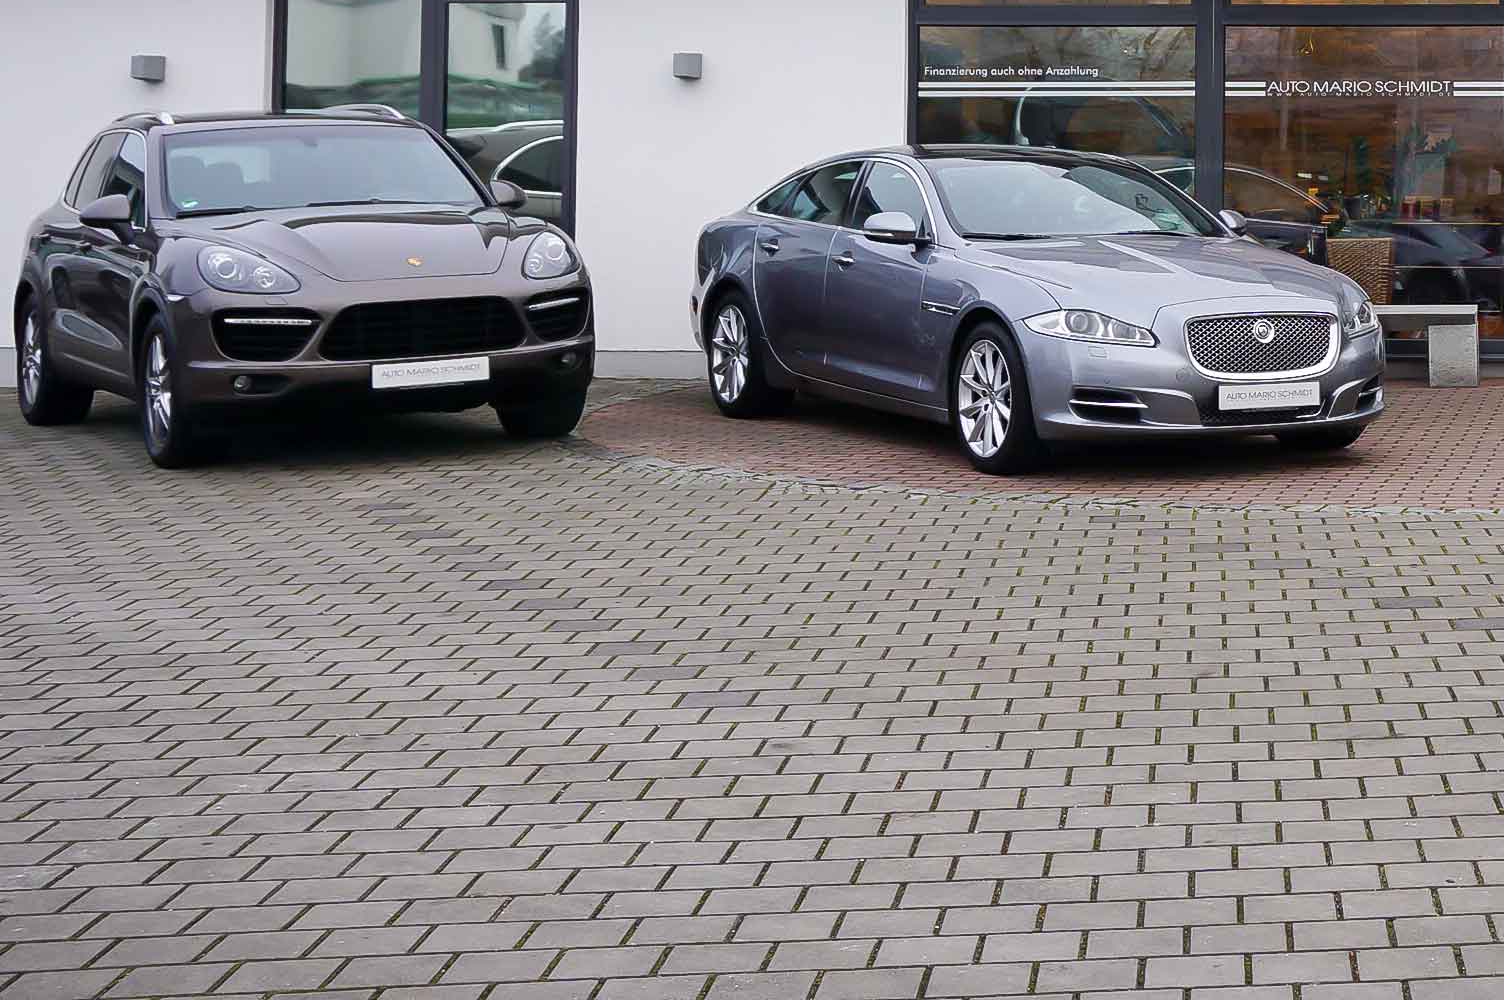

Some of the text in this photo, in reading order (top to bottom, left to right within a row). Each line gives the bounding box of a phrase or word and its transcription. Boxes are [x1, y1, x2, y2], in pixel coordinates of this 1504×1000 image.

[924, 66, 1099, 77] Finanzierung auch ohne Anzahlung
[1267, 80, 1451, 93] AUTO MARIO SCHMIDT
[382, 369, 405, 377] AUTO
[406, 367, 440, 377] MARIO
[1226, 392, 1247, 400] AUTO
[1248, 391, 1277, 399] MARIO
